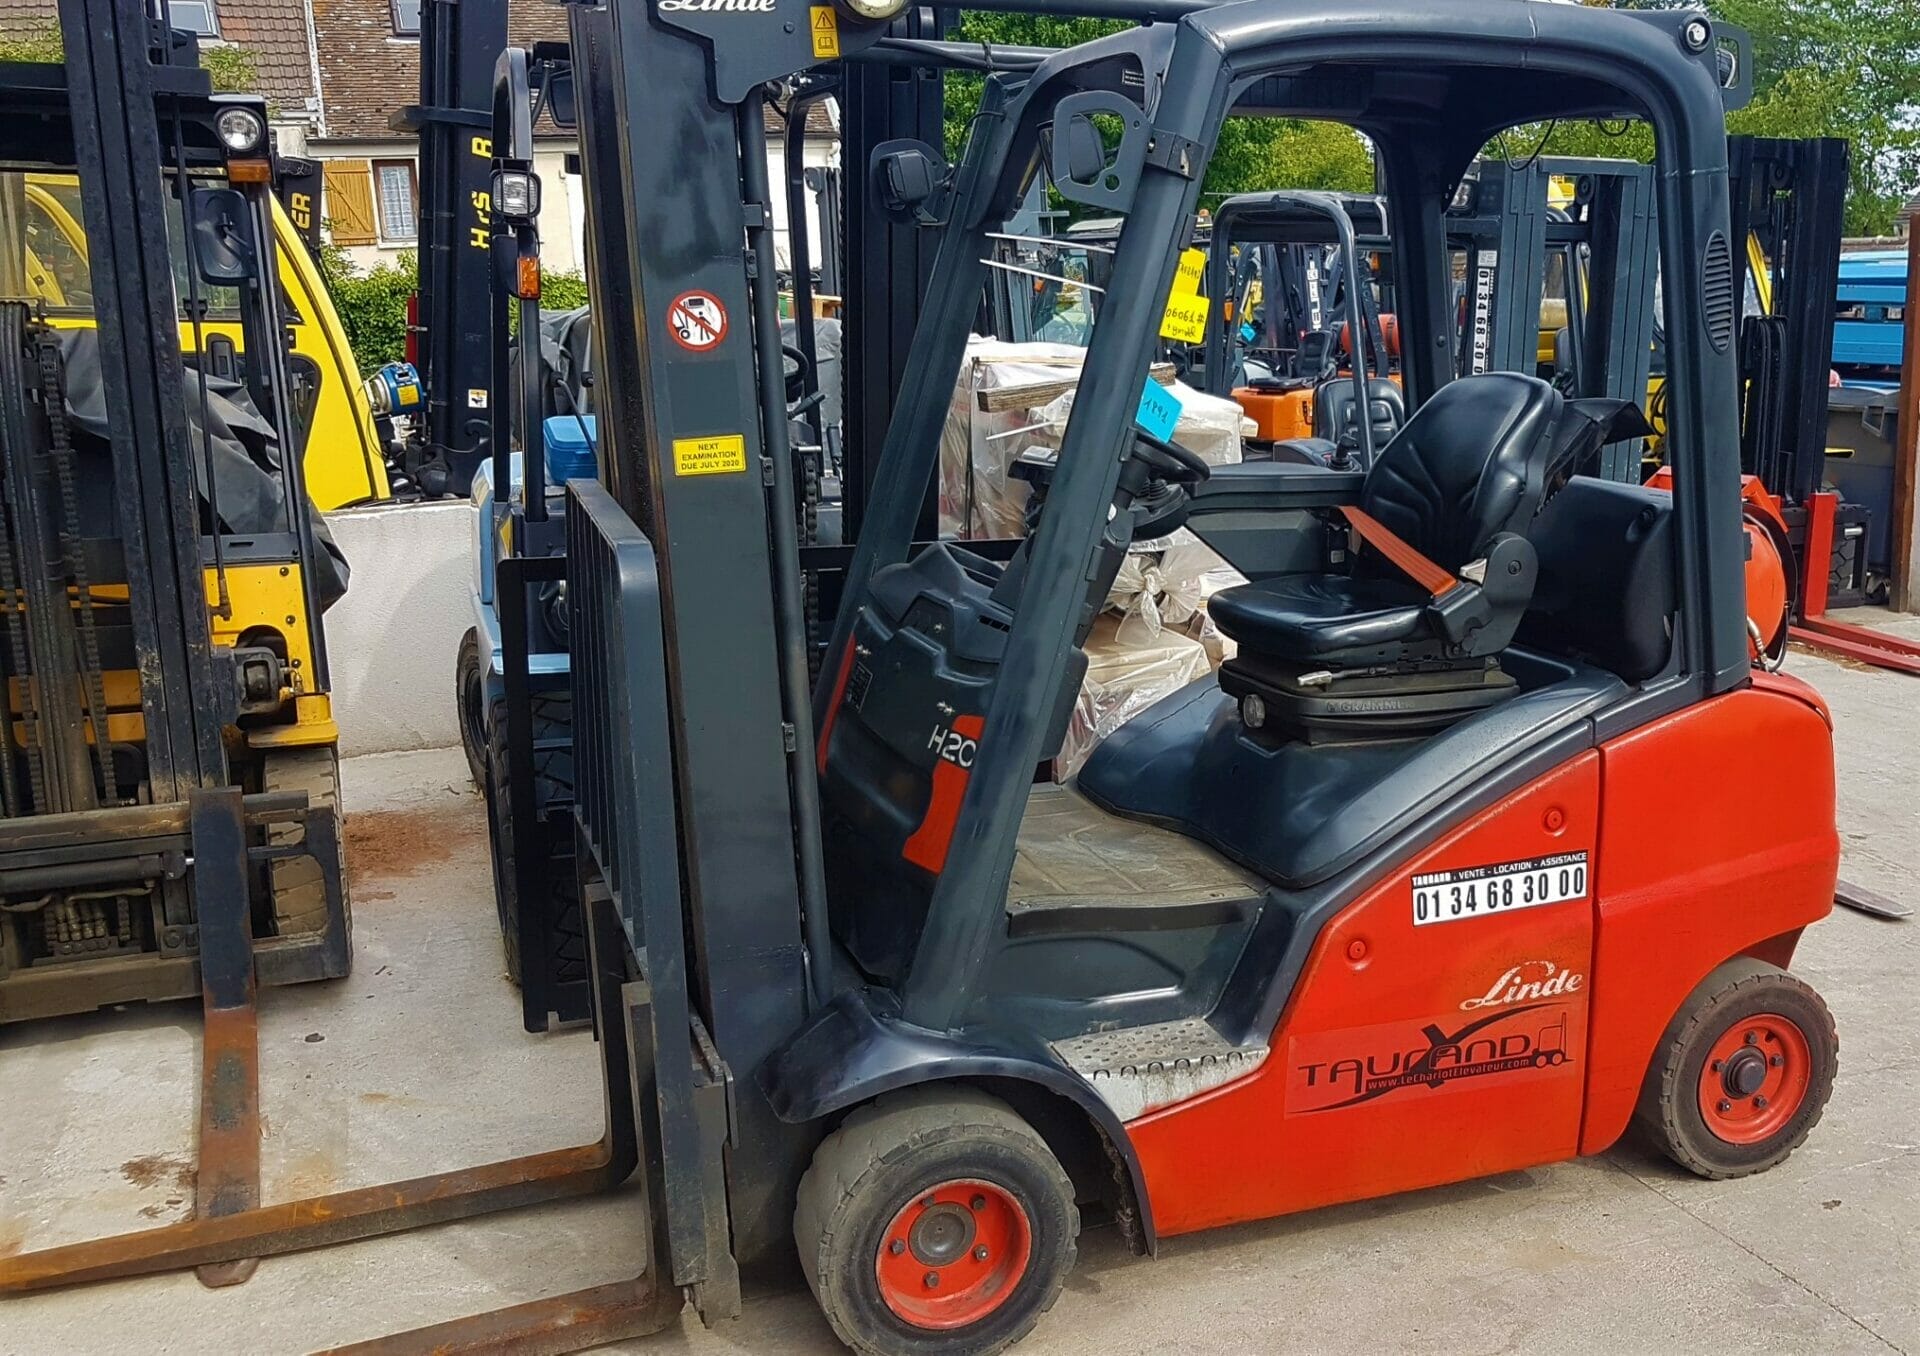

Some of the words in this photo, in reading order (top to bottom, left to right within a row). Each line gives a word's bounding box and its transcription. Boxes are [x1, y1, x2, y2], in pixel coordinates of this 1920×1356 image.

[1478, 270, 1489, 287] 01
[1477, 292, 1488, 310] 34
[1475, 317, 1486, 335] 68
[1474, 341, 1485, 360] 30
[682, 450, 737, 461] EXAMINATION
[698, 442, 719, 451] NEXT
[681, 462, 698, 471] DUE
[699, 461, 720, 469] JULY
[722, 459, 740, 467] 2020
[1458, 868, 1485, 881] VENTE
[1493, 861, 1532, 876] LOCATION
[1539, 852, 1587, 867] ASSISTANCE
[1416, 889, 1440, 921] 01
[1450, 884, 1477, 915] 34
[1487, 878, 1513, 909] 68
[1523, 873, 1549, 903] 30
[1559, 867, 1584, 897] 00
[1459, 960, 1583, 1011] Linde
